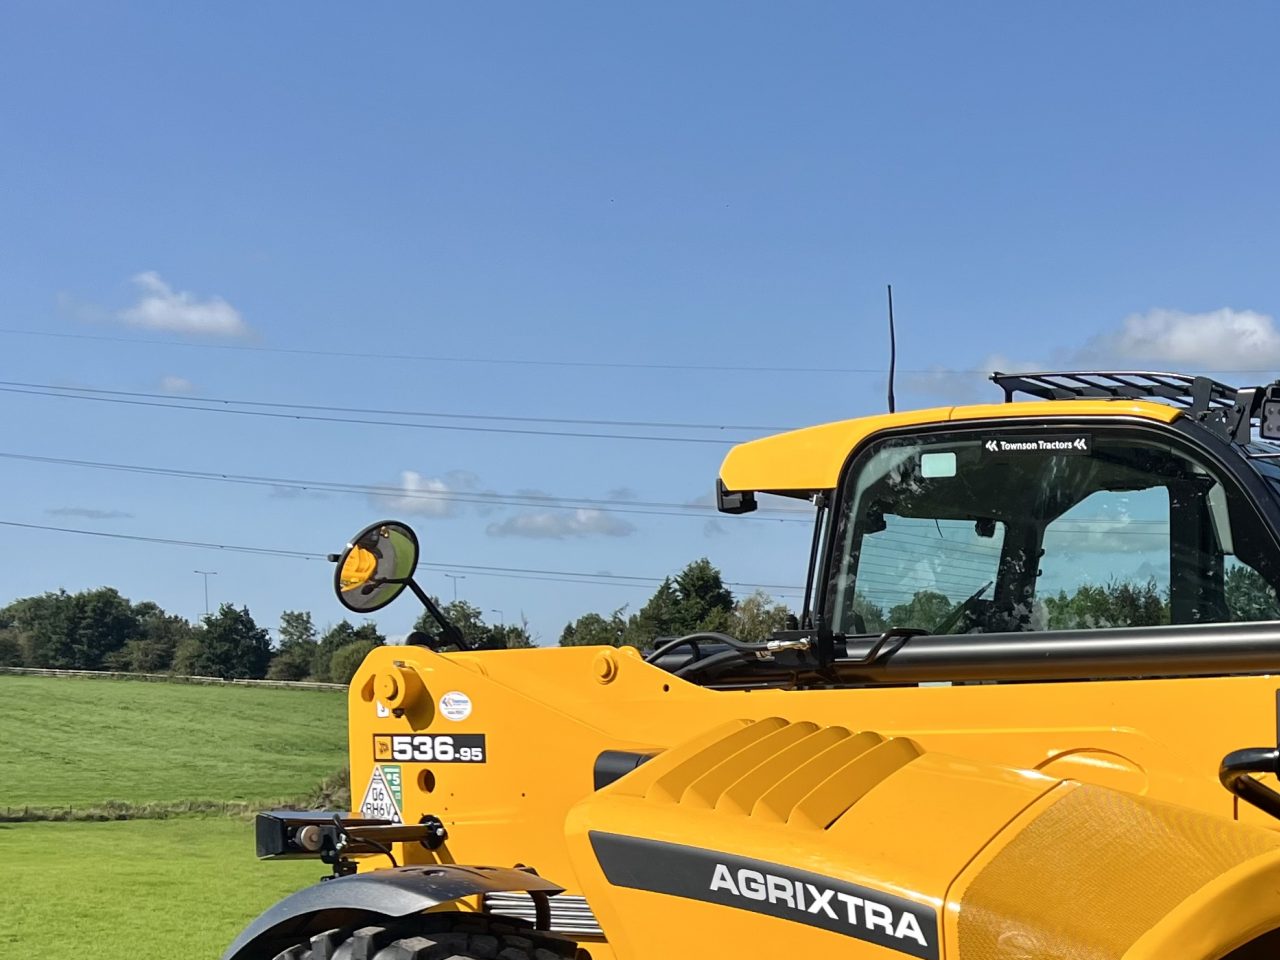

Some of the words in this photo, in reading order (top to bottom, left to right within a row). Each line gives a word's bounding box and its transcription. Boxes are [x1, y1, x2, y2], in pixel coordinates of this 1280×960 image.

[1000, 441, 1037, 450] Townson
[1038, 440, 1072, 449] Tractors
[393, 736, 483, 760] 536-95
[709, 863, 928, 947] AGRIXTRA
